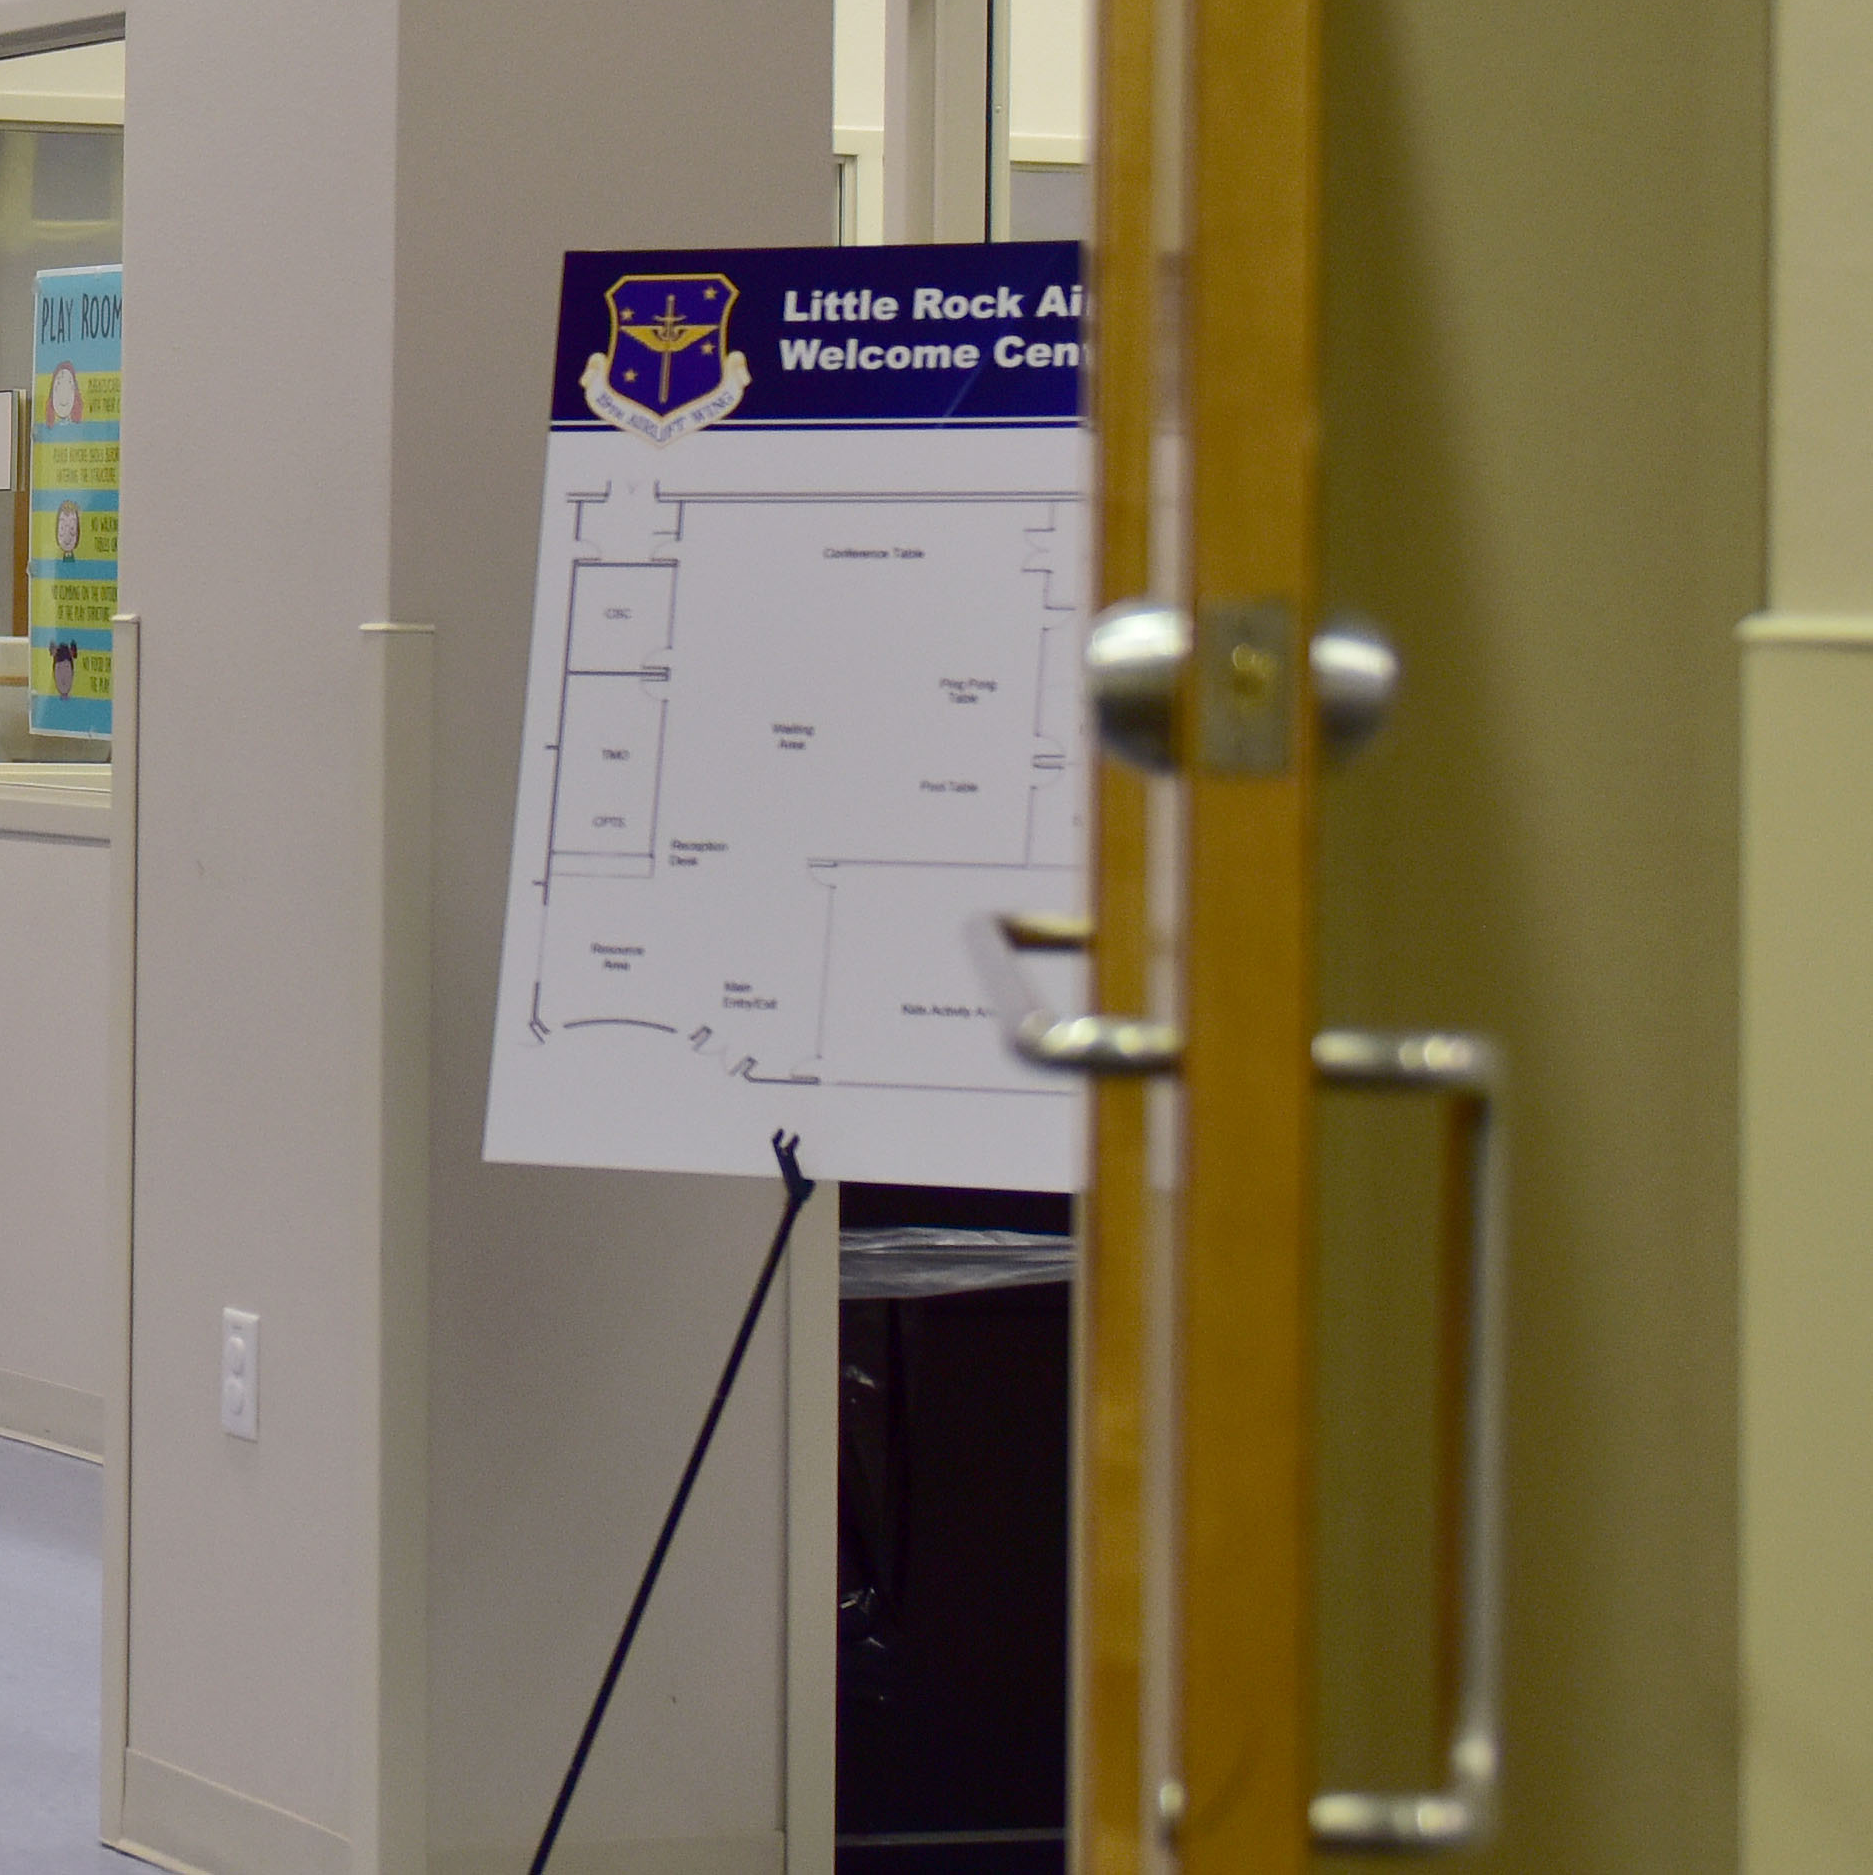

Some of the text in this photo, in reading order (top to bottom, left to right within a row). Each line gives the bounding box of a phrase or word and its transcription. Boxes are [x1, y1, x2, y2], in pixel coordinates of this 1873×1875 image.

[41, 293, 122, 344] PLAY ROOM
[783, 284, 1091, 321] Little Rock Ai
[778, 337, 981, 371] Welcome
[823, 547, 925, 559] Conference Table
[949, 780, 978, 792] Table
